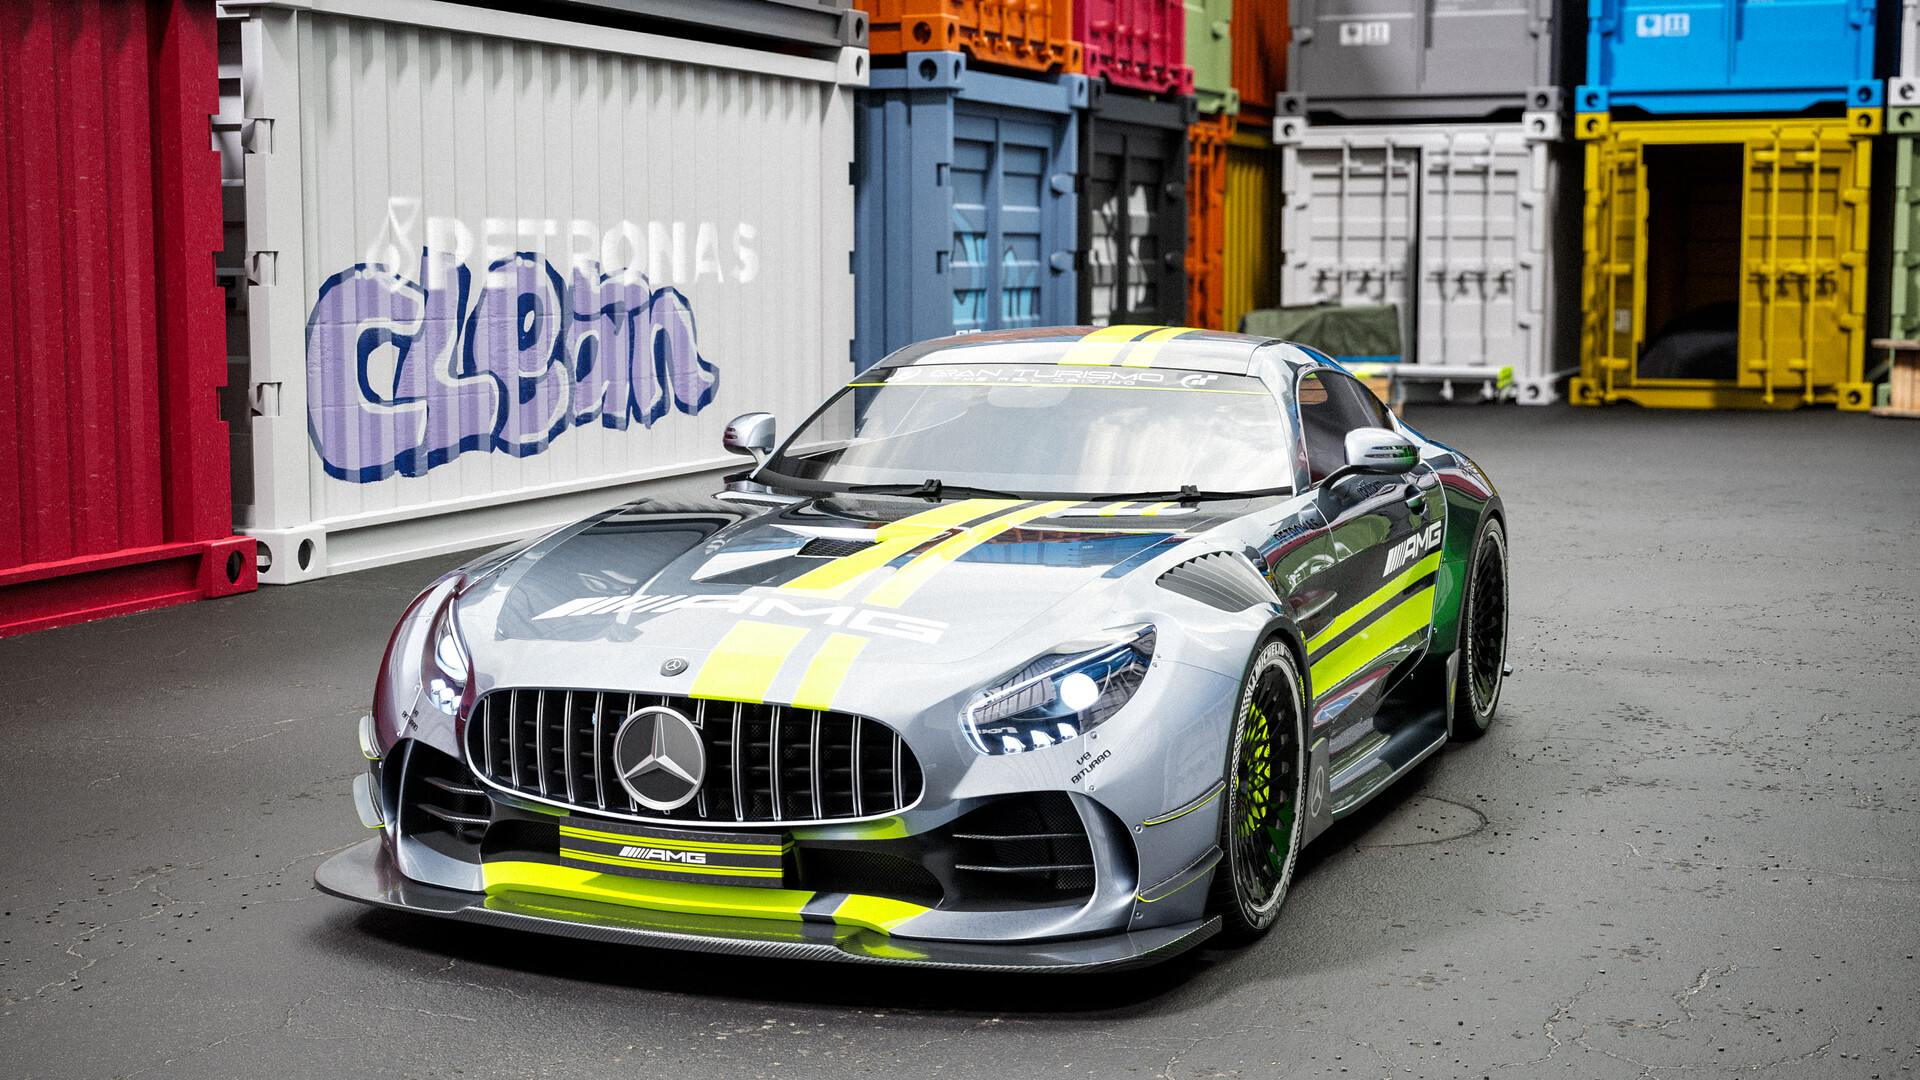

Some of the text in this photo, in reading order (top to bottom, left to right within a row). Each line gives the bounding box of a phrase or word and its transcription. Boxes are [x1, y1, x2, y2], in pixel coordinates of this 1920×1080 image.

[427, 216, 758, 290] PETRONAS
[930, 368, 1164, 382] GRAN TURISMO
[1052, 378, 1136, 386] DRIVING
[1272, 518, 1321, 543] PETRONAS
[1071, 749, 1112, 784] BITURBO
[1076, 751, 1092, 765] V8
